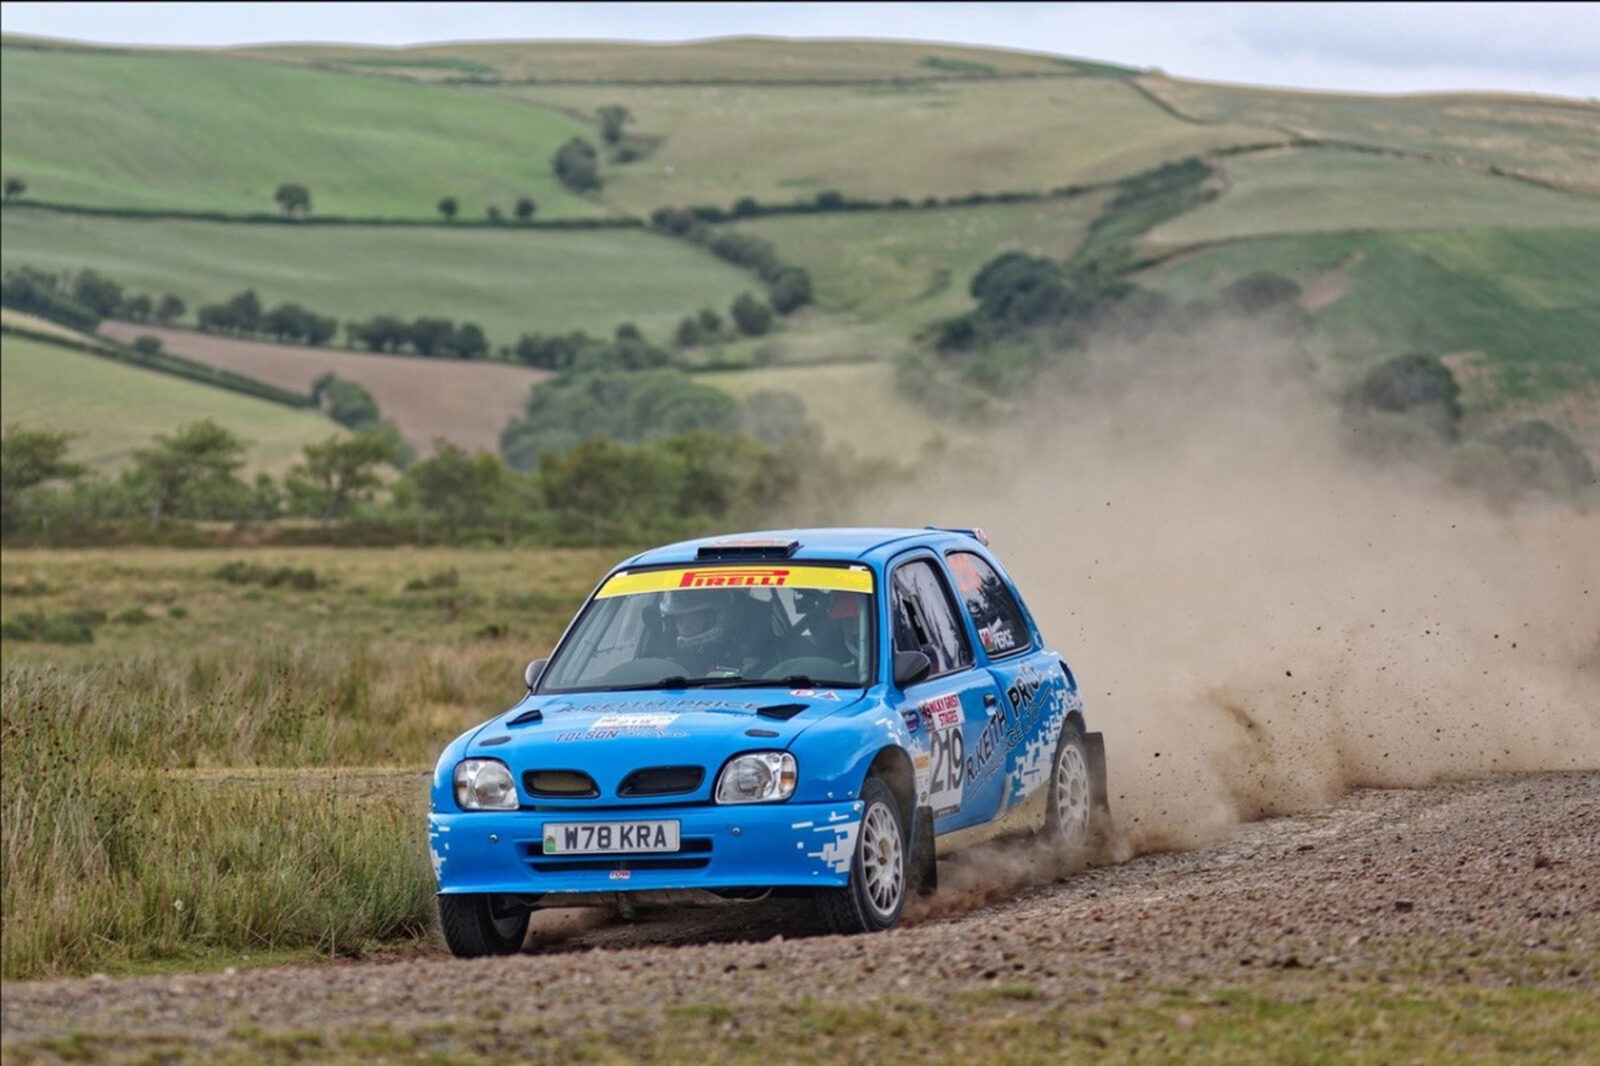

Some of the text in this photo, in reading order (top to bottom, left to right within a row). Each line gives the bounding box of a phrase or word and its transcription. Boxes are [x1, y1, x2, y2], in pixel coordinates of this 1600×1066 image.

[679, 569, 791, 588] PIRELLI
[556, 730, 619, 742] TOLSON
[929, 728, 965, 795] 219
[564, 824, 668, 850] W78 KRA
